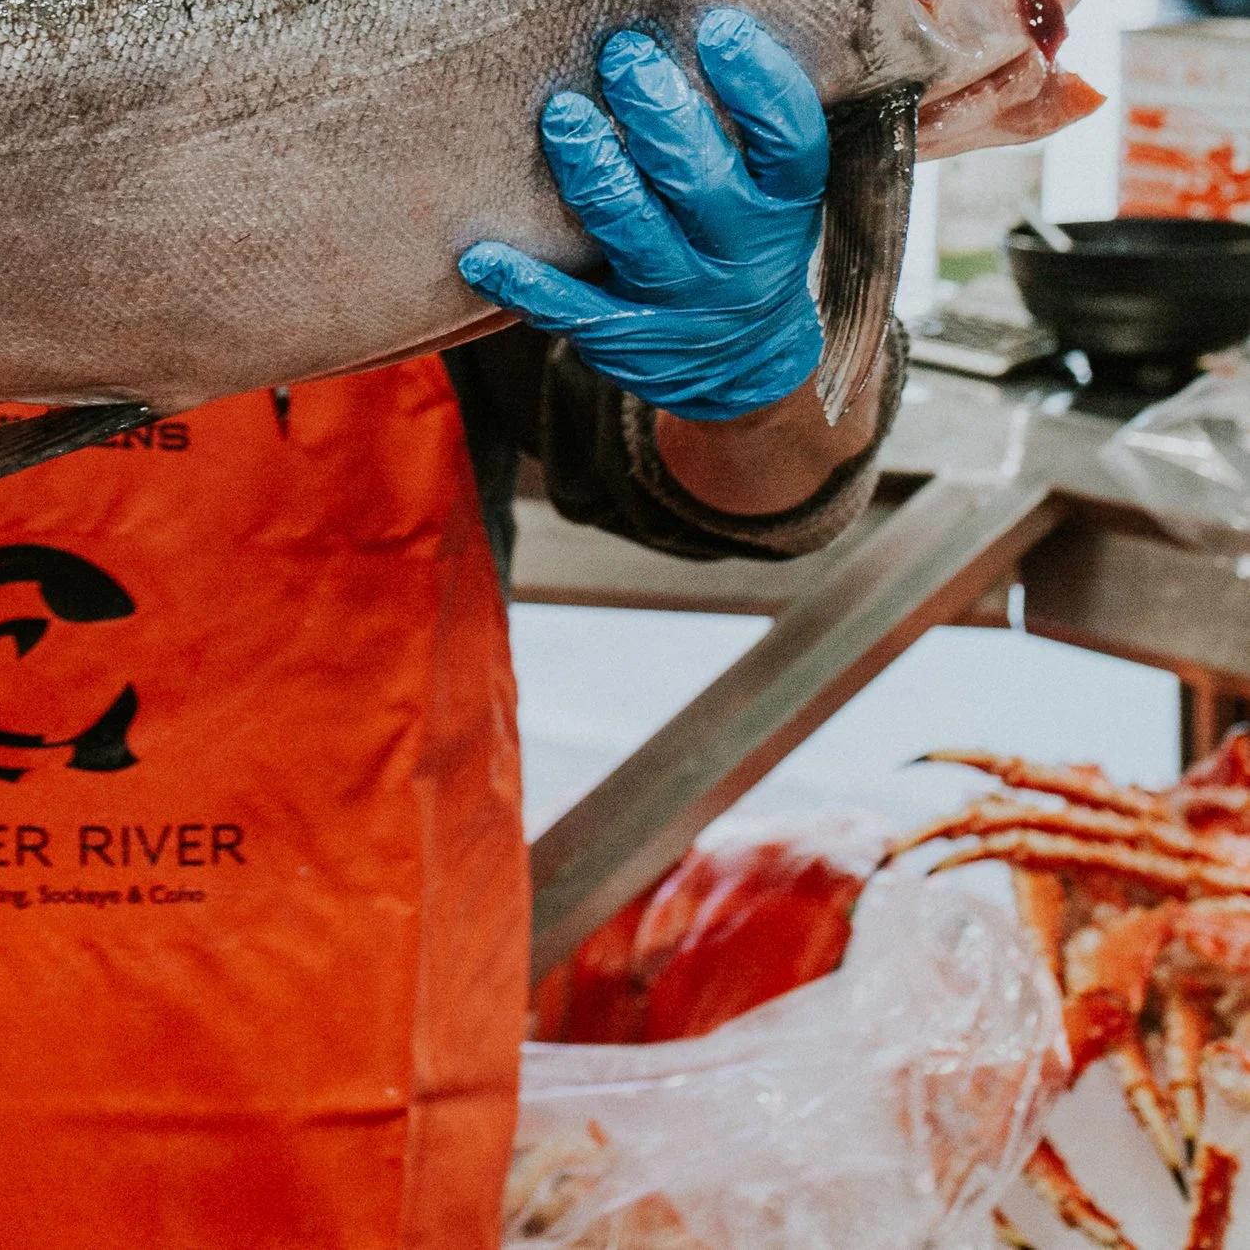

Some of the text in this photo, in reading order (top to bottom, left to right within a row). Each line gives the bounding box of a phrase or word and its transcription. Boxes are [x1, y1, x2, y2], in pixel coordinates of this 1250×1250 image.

[78, 823, 247, 867] RIVER
[37, 884, 121, 909] Sockeye
[127, 885, 142, 904] &
